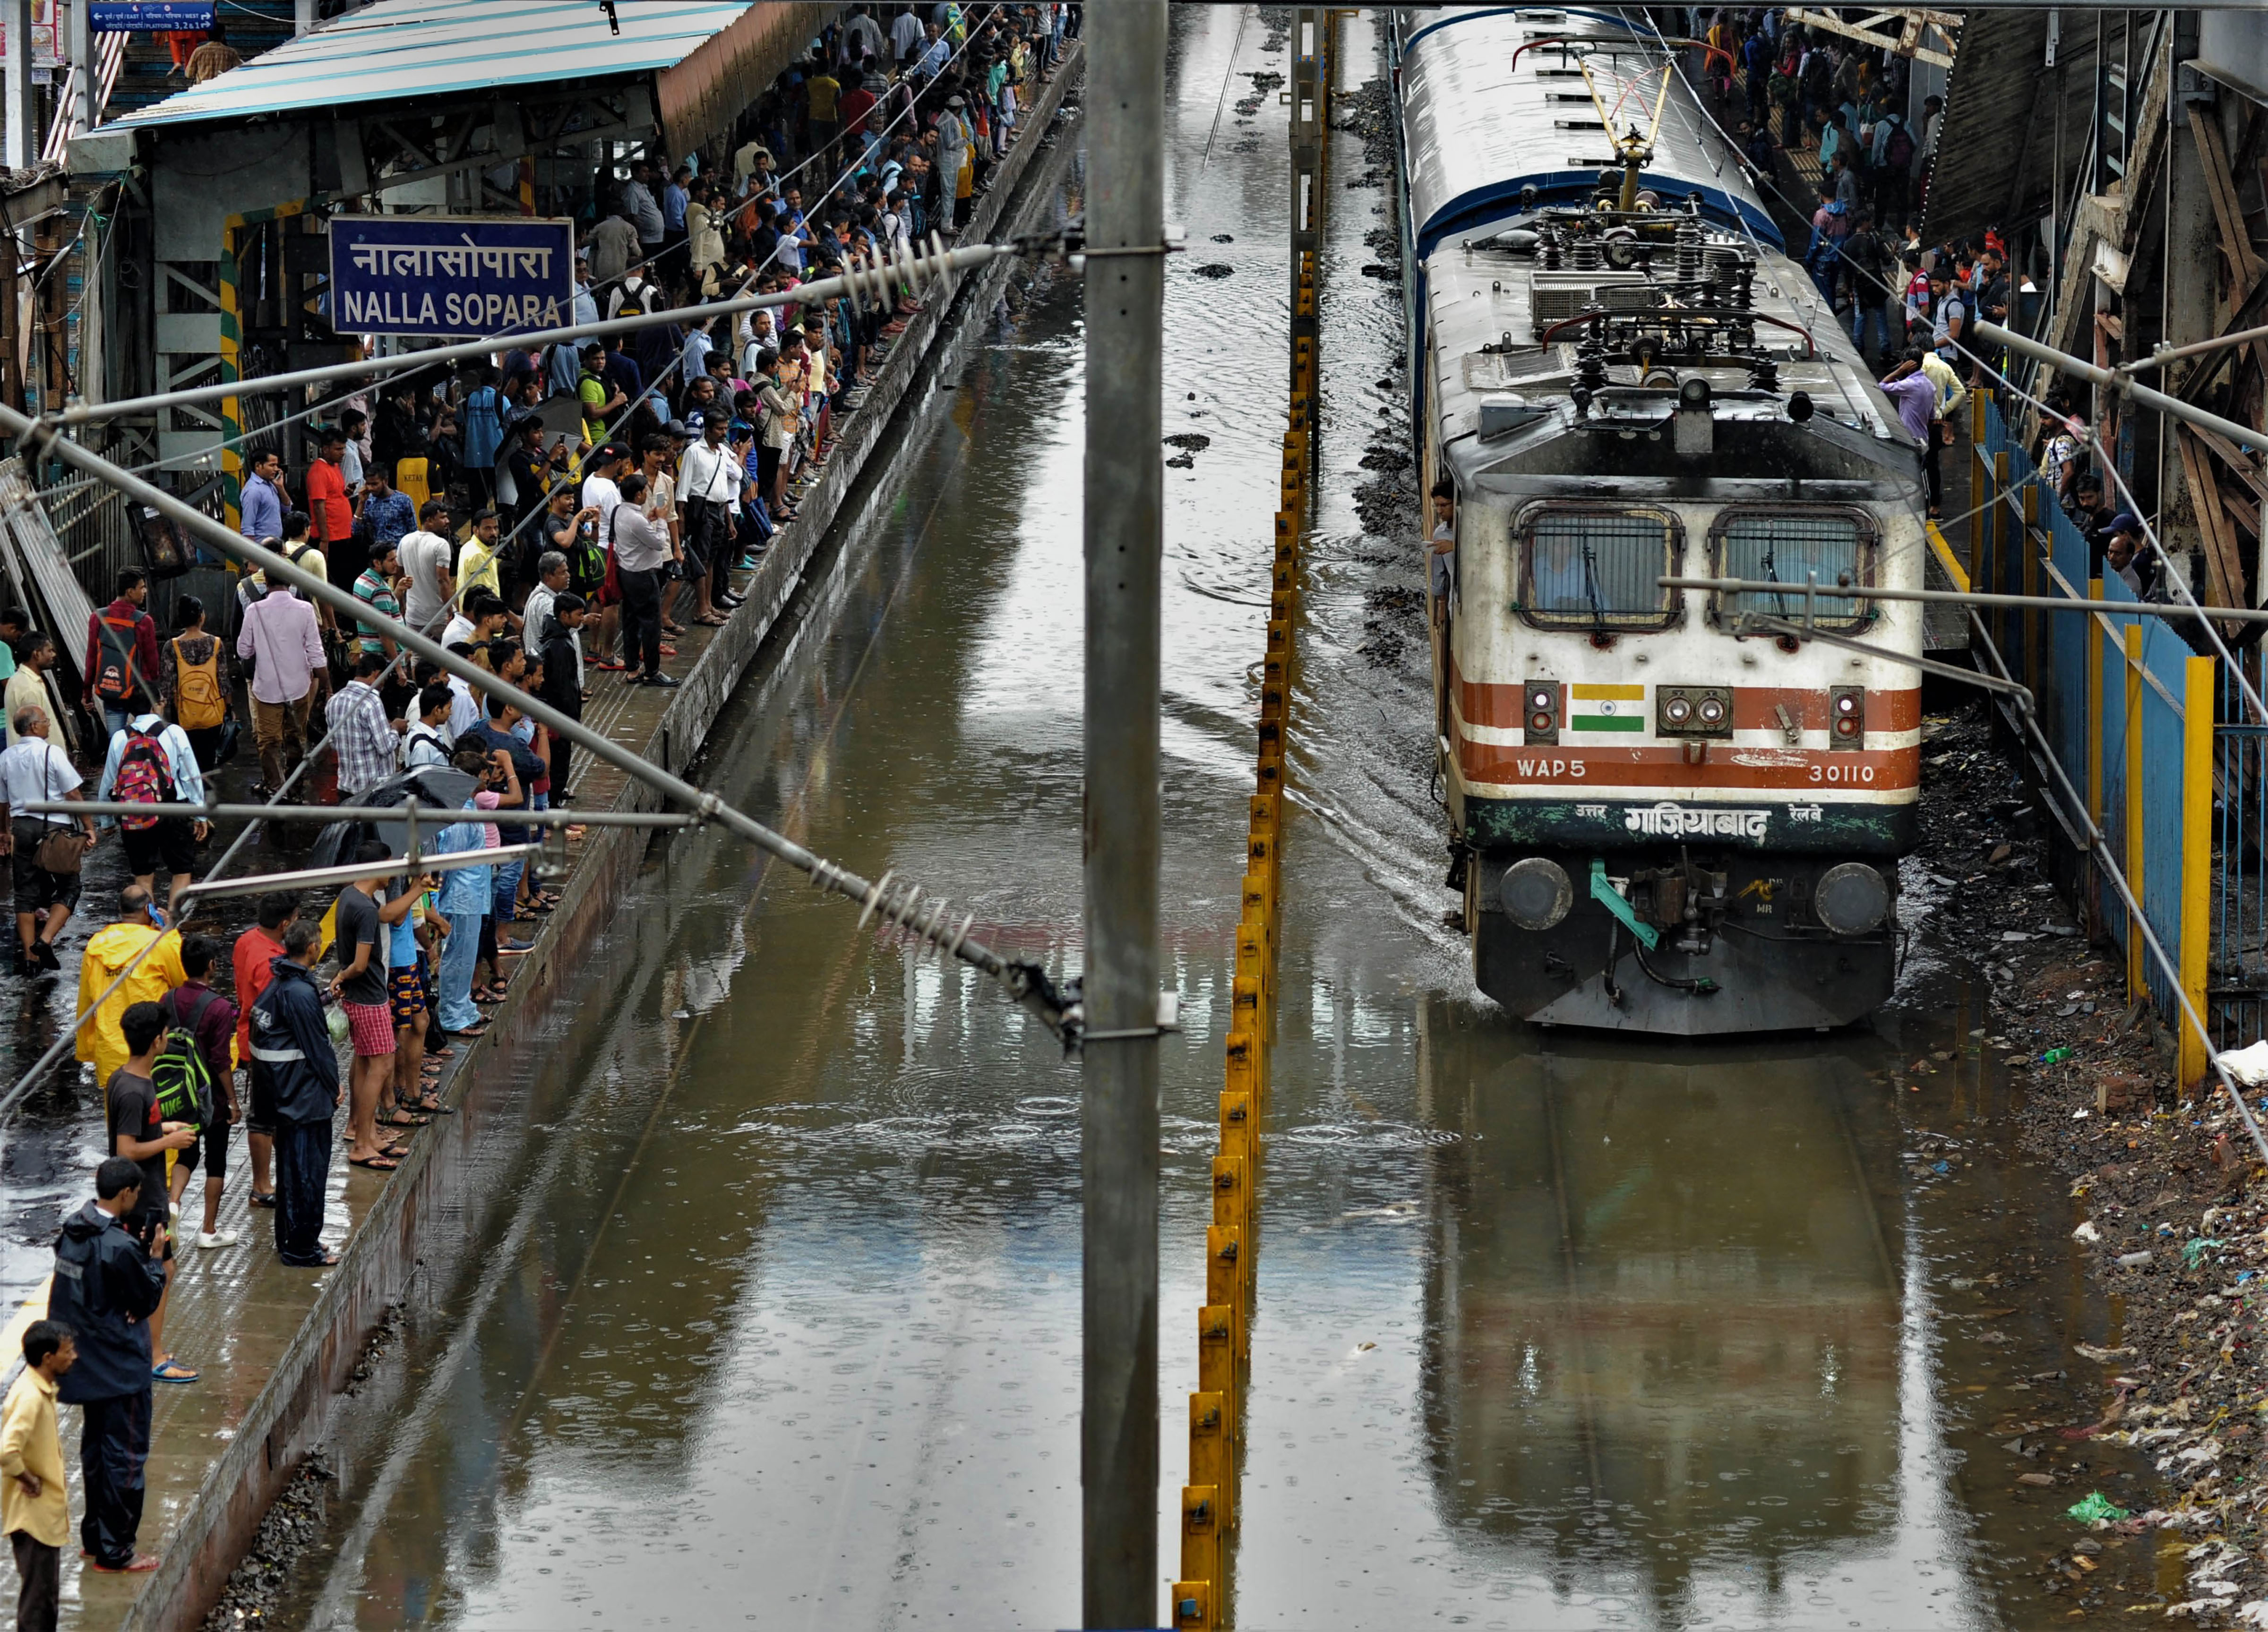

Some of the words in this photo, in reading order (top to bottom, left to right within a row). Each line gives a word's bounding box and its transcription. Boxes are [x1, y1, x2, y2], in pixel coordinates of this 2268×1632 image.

[350, 232, 553, 279] नालासोपारा
[344, 291, 438, 325] NALLA
[446, 293, 562, 327] SOPARA
[1809, 765, 1874, 782] 30110
